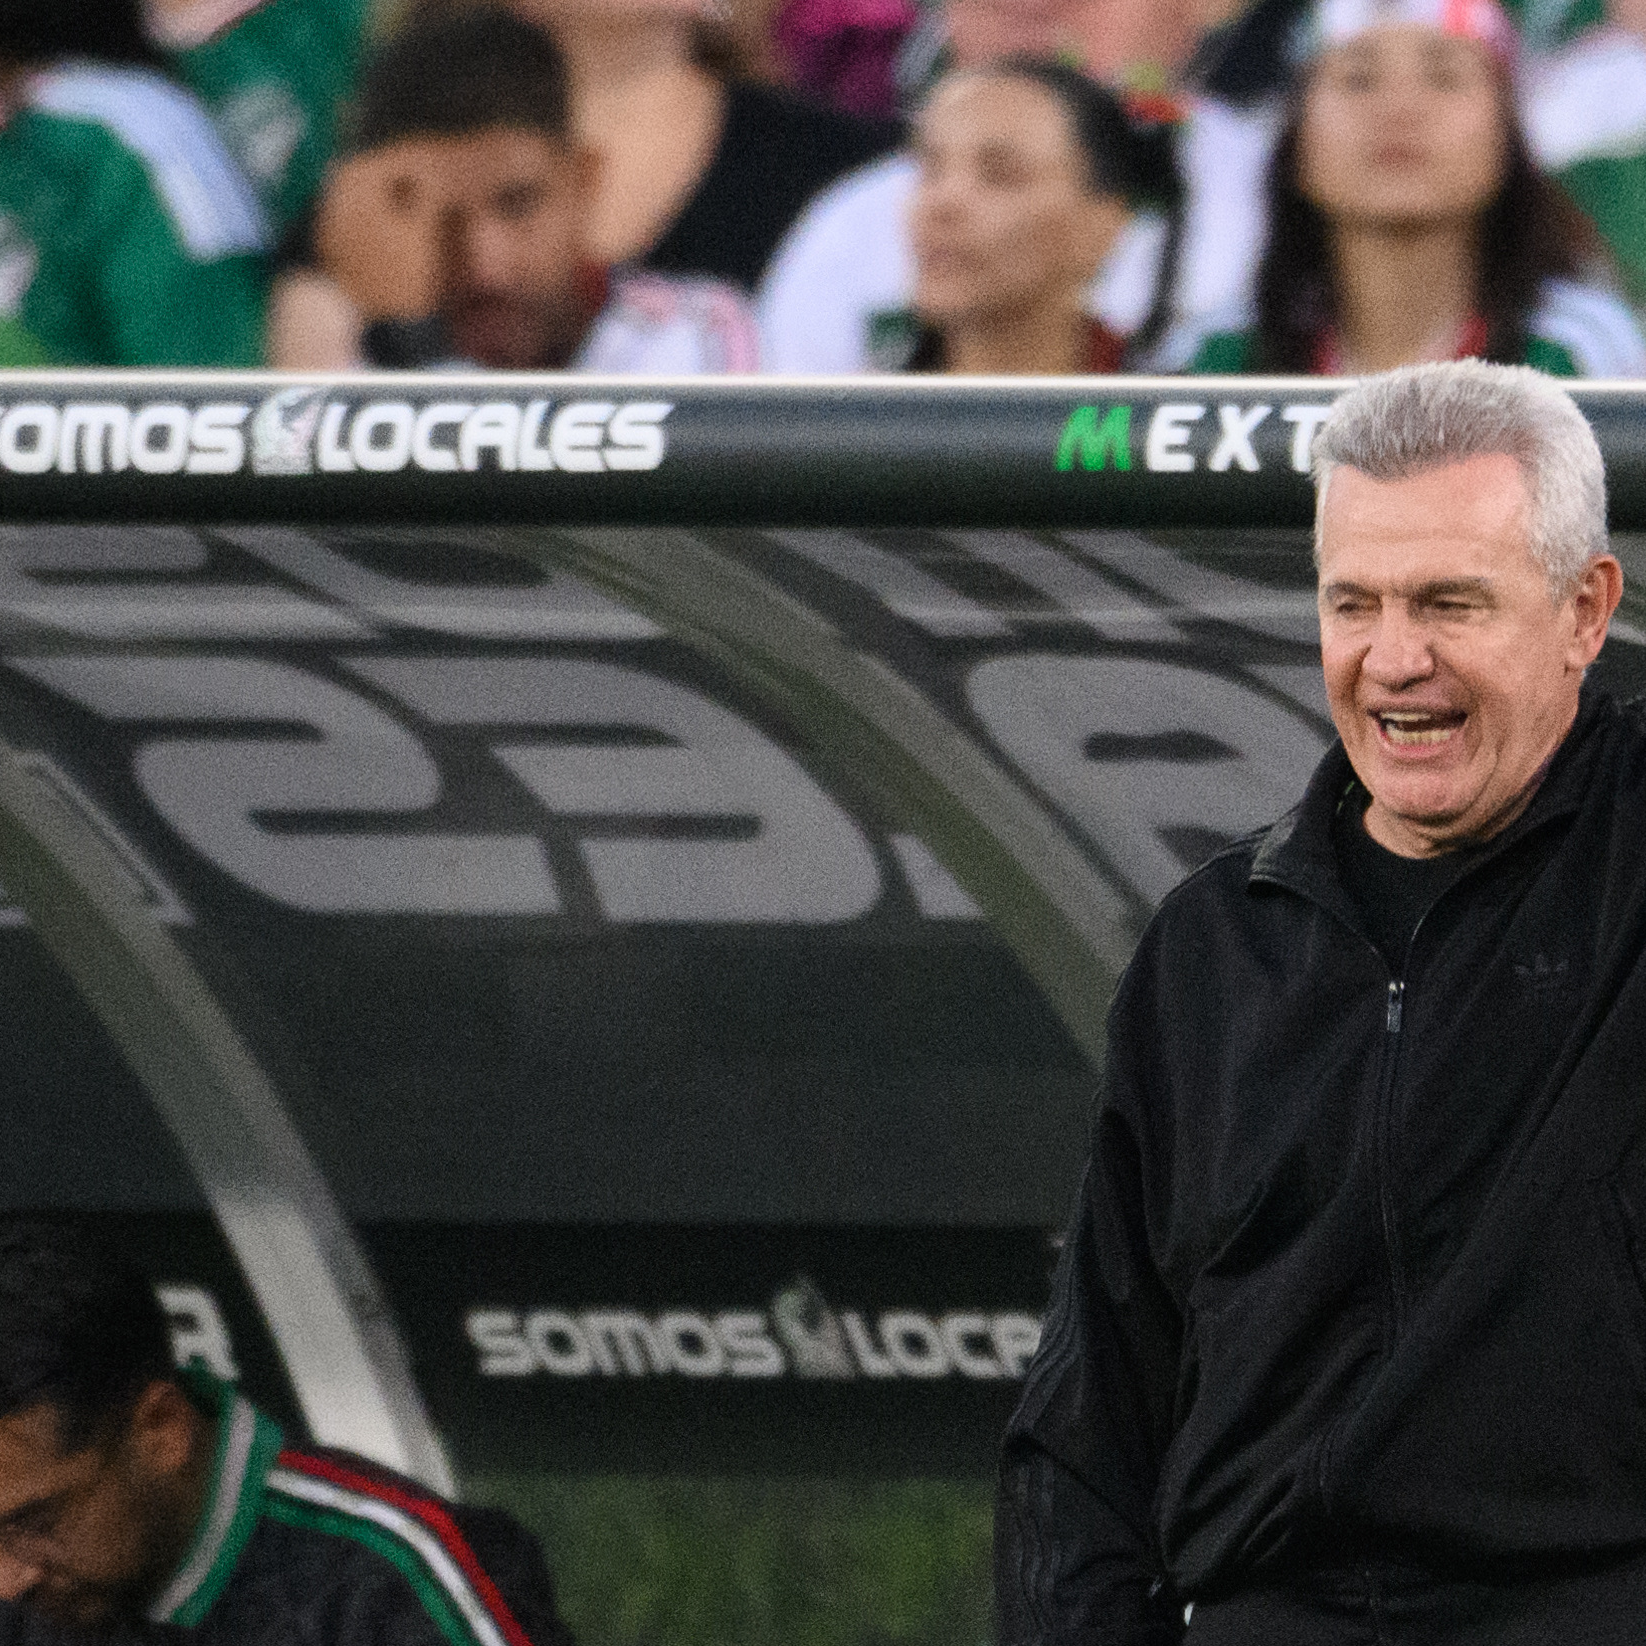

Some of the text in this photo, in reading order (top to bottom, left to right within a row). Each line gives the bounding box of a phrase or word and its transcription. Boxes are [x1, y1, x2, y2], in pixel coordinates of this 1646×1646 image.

[321, 402, 671, 472] LOCALES
[1054, 404, 1333, 472] MEXT
[465, 1309, 1045, 1379] SOMOS LOCA
